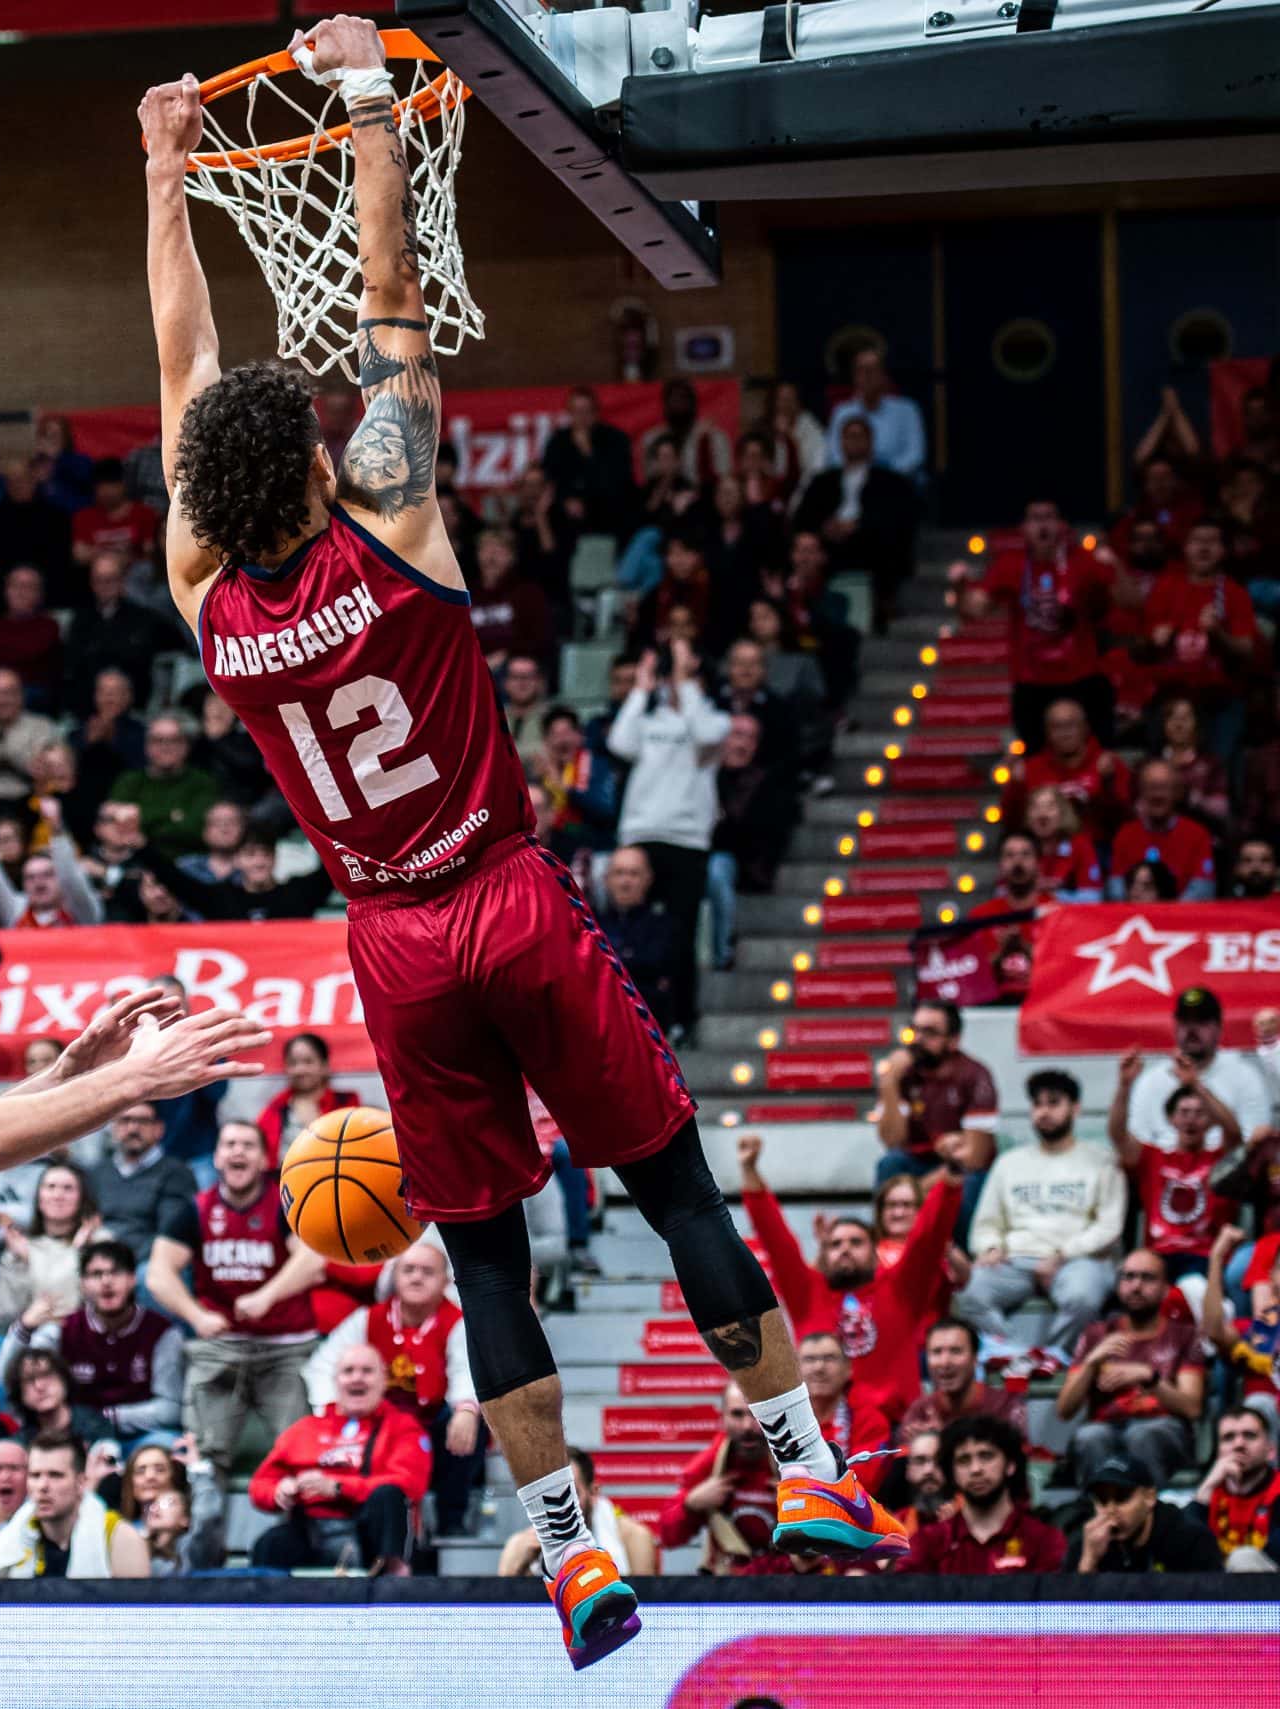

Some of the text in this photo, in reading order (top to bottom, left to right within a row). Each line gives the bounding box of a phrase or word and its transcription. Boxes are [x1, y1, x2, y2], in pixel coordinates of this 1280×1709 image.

[214, 581, 383, 677] RADEBAUGH
[278, 674, 441, 822] 12
[202, 1239, 275, 1268] UCAM
